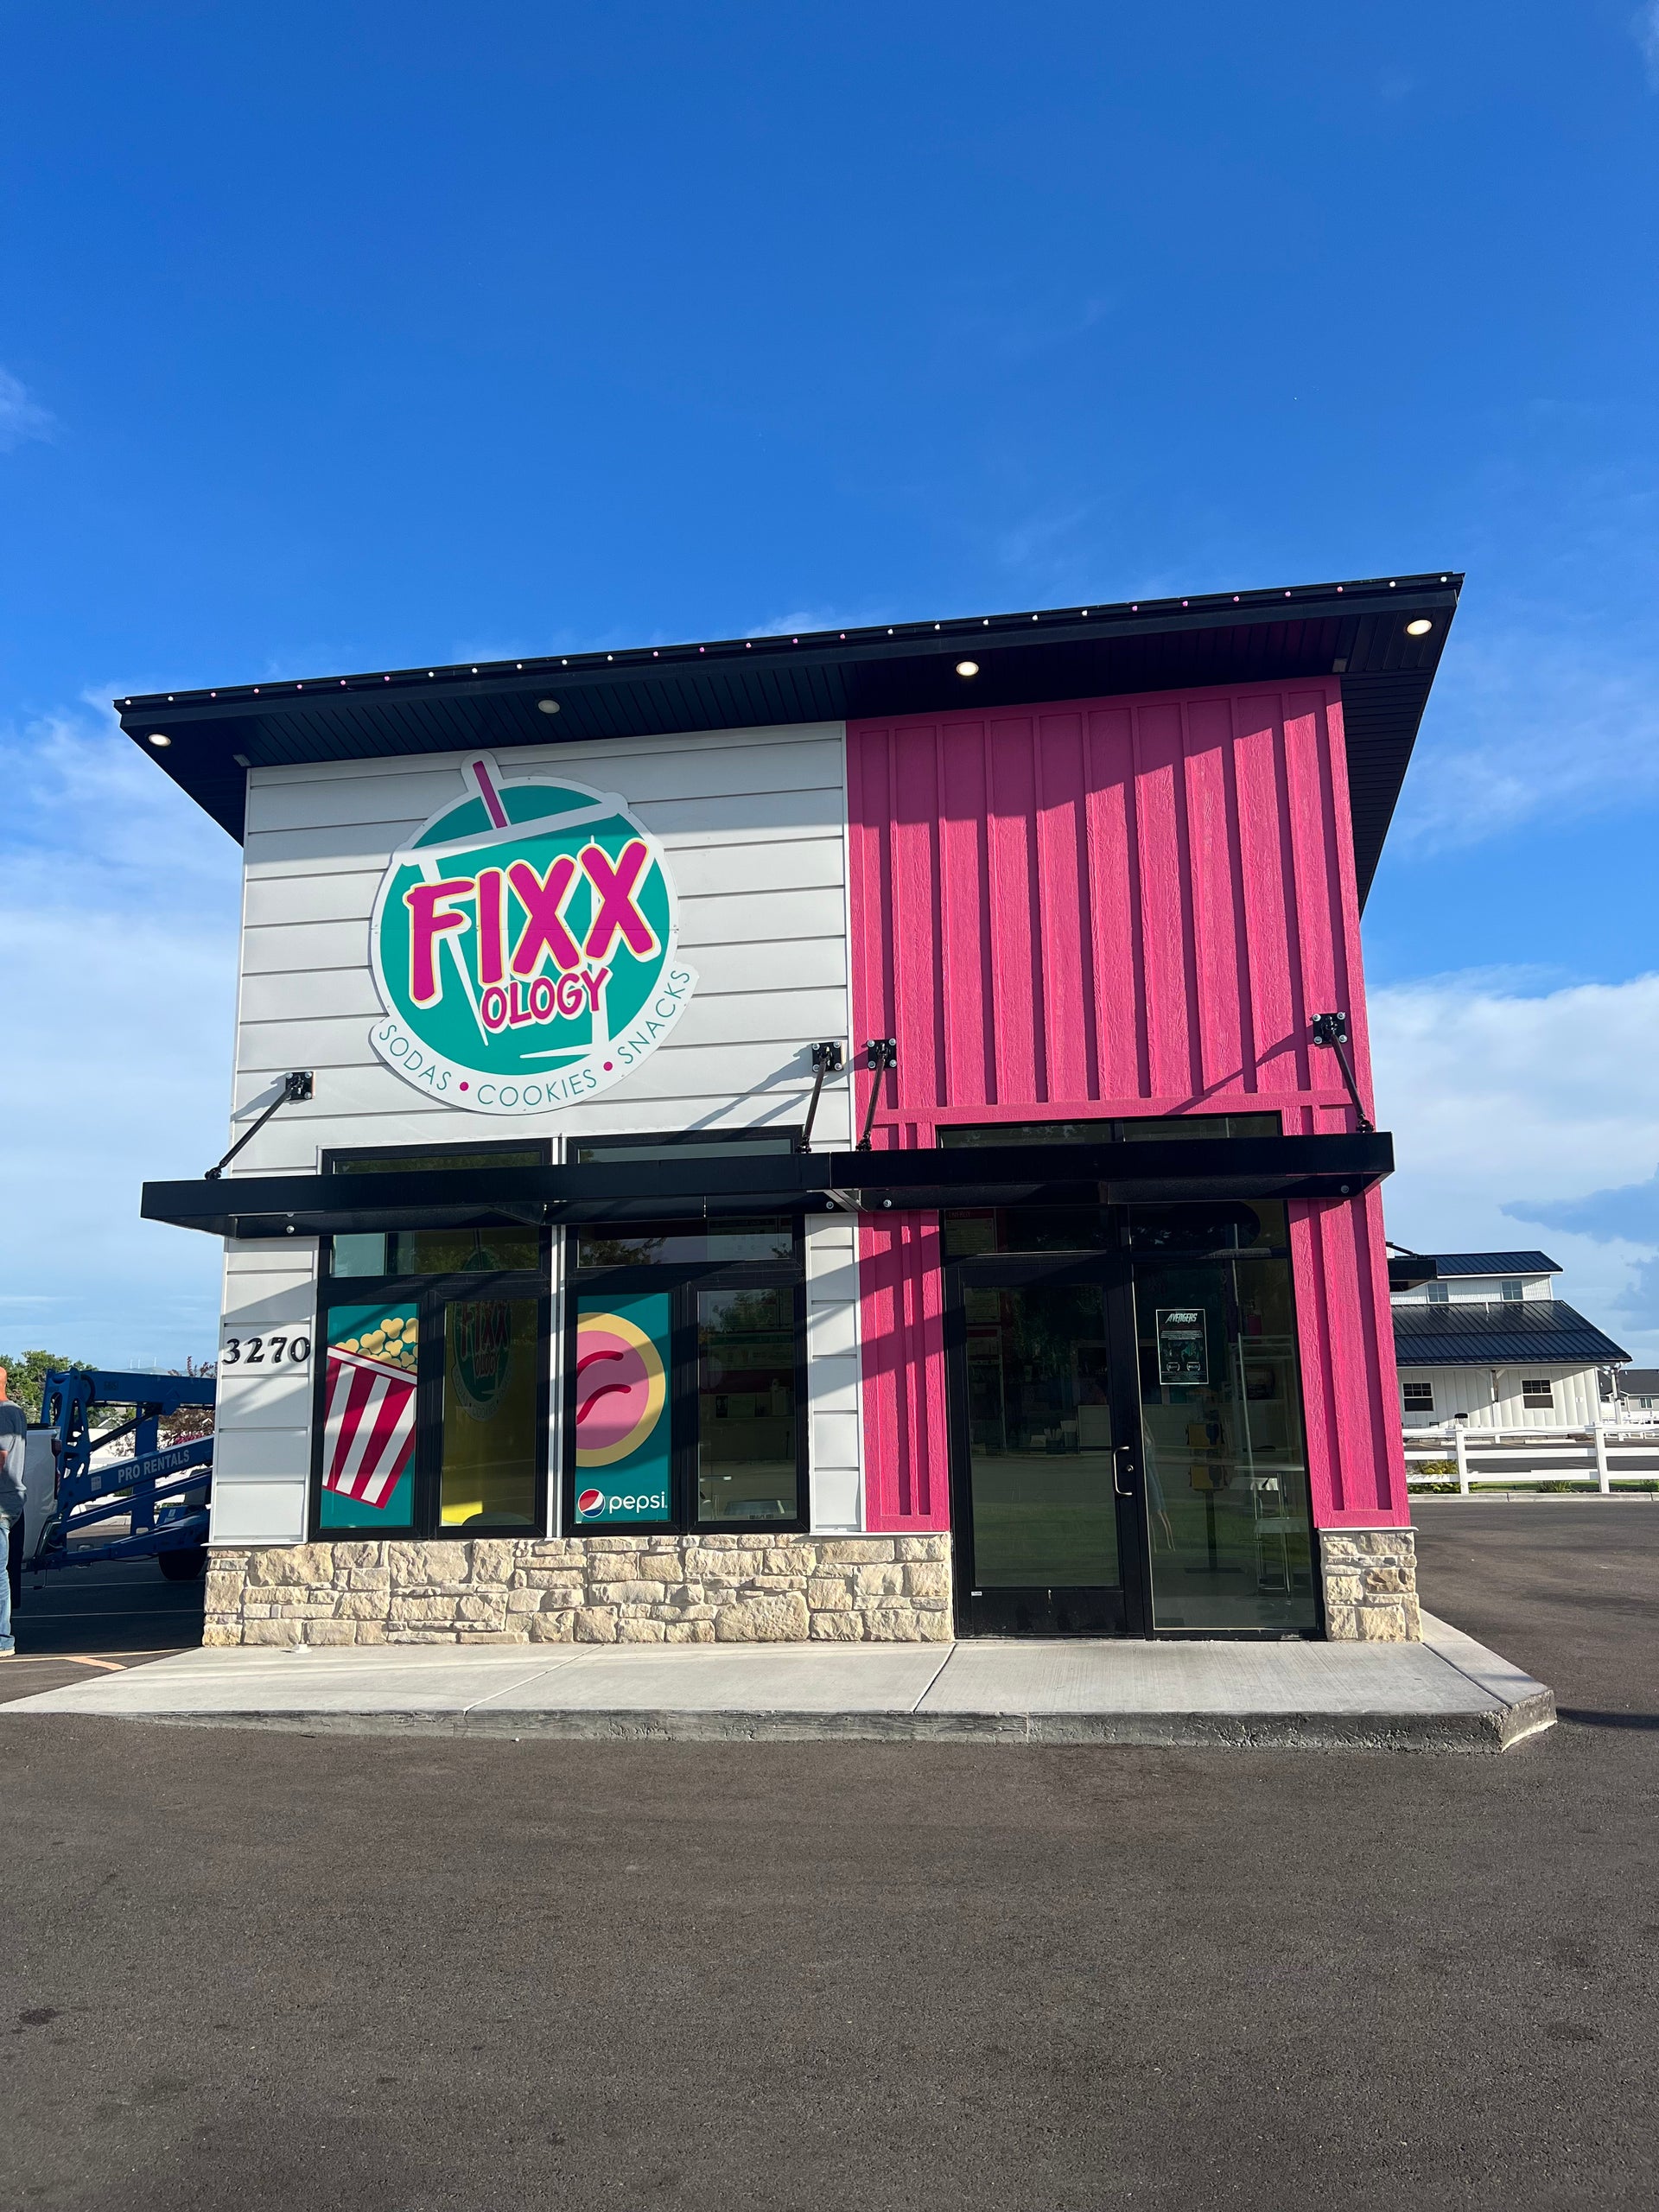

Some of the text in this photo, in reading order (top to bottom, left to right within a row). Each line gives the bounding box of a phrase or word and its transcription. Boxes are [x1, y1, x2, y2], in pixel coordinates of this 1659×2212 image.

[405, 841, 654, 1003] FIXX
[480, 967, 610, 1029] OLOGY
[378, 969, 690, 1107] SODAS COOKIES SNACKS
[222, 1337, 311, 1364] 3270
[118, 1449, 190, 1484] PRO RENTALS
[609, 1491, 665, 1514] pepsi
